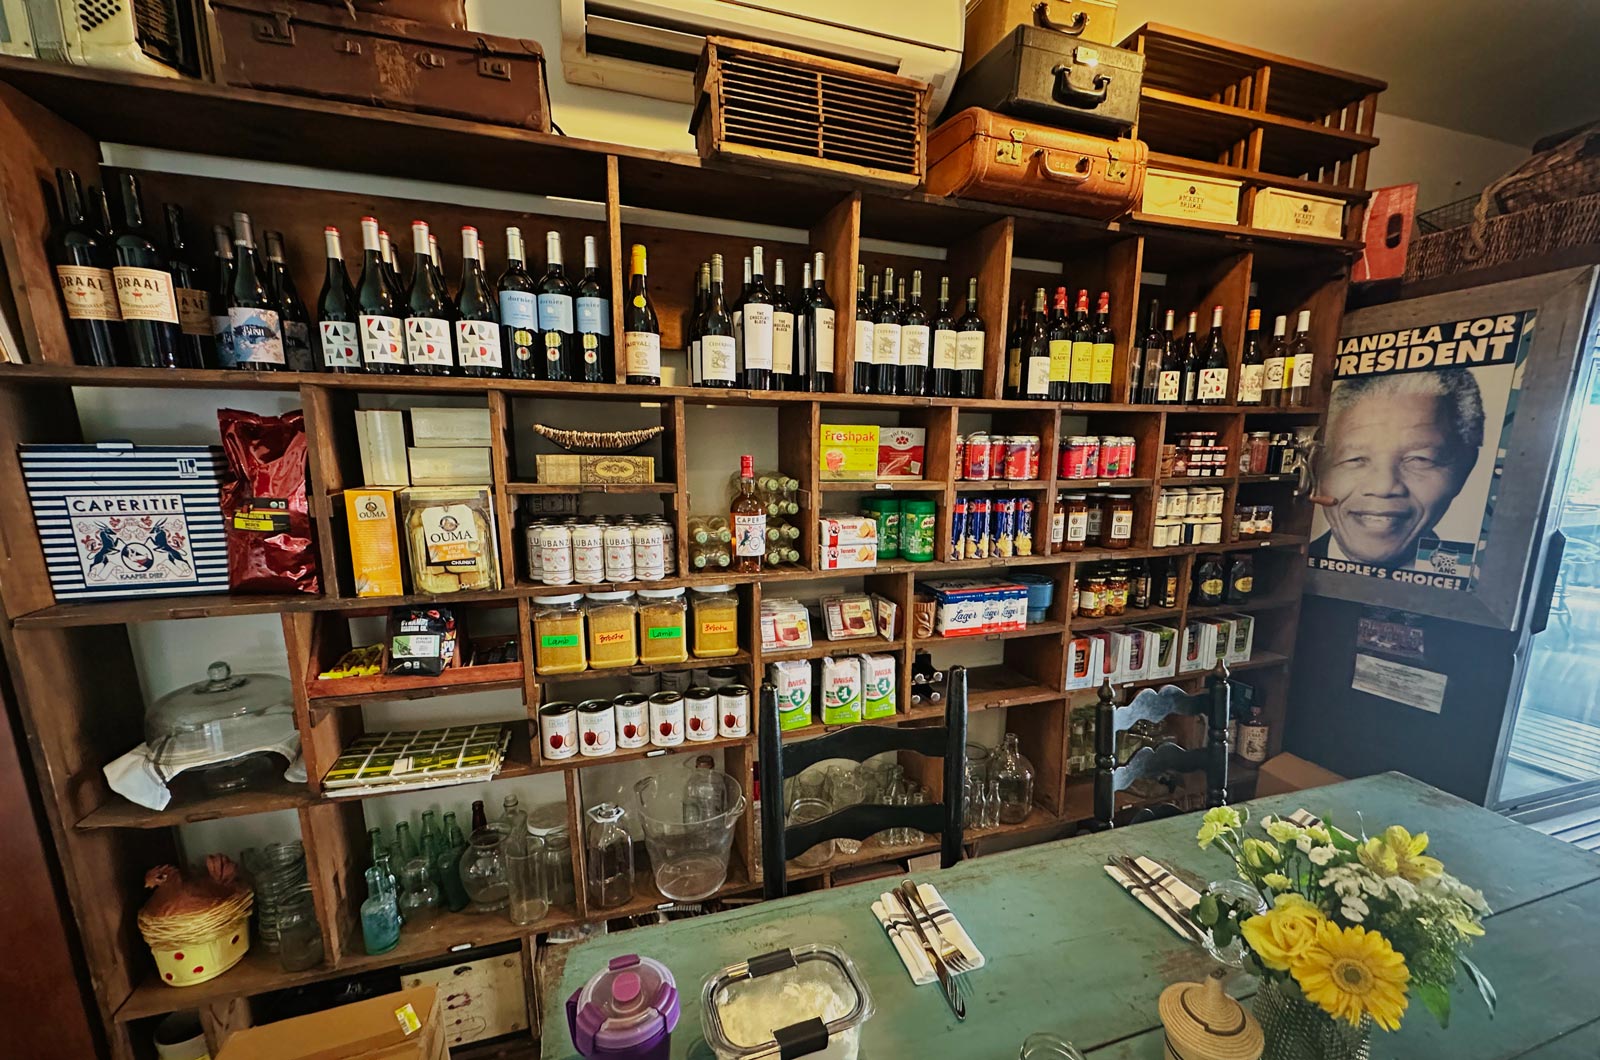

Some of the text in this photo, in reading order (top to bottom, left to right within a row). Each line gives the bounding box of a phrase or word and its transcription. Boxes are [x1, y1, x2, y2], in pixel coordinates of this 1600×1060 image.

[59, 276, 104, 291] BRAAI
[117, 277, 160, 293] BRAAI
[507, 295, 534, 304] dornier
[408, 321, 444, 342] KARA
[461, 324, 496, 343] KARA
[1454, 315, 1517, 340] FOR
[825, 430, 875, 444] Freshpak
[73, 498, 179, 512] CAPERITIF
[359, 511, 386, 519] OUMA
[430, 530, 473, 544] OUMA
[542, 539, 570, 547] UBANZ
[574, 539, 602, 547] LUBANZ
[606, 538, 633, 546] LUBANZ
[1319, 559, 1387, 578] PEOPLE'S
[1392, 571, 1462, 590] CHOICE!
[1438, 567, 1457, 575] ANC
[950, 609, 977, 624] Lager
[982, 607, 999, 620] Lager
[1002, 605, 1019, 618] Lager
[652, 630, 673, 638] Lamb
[787, 679, 807, 687] IWISA
[833, 677, 854, 685] IWISA
